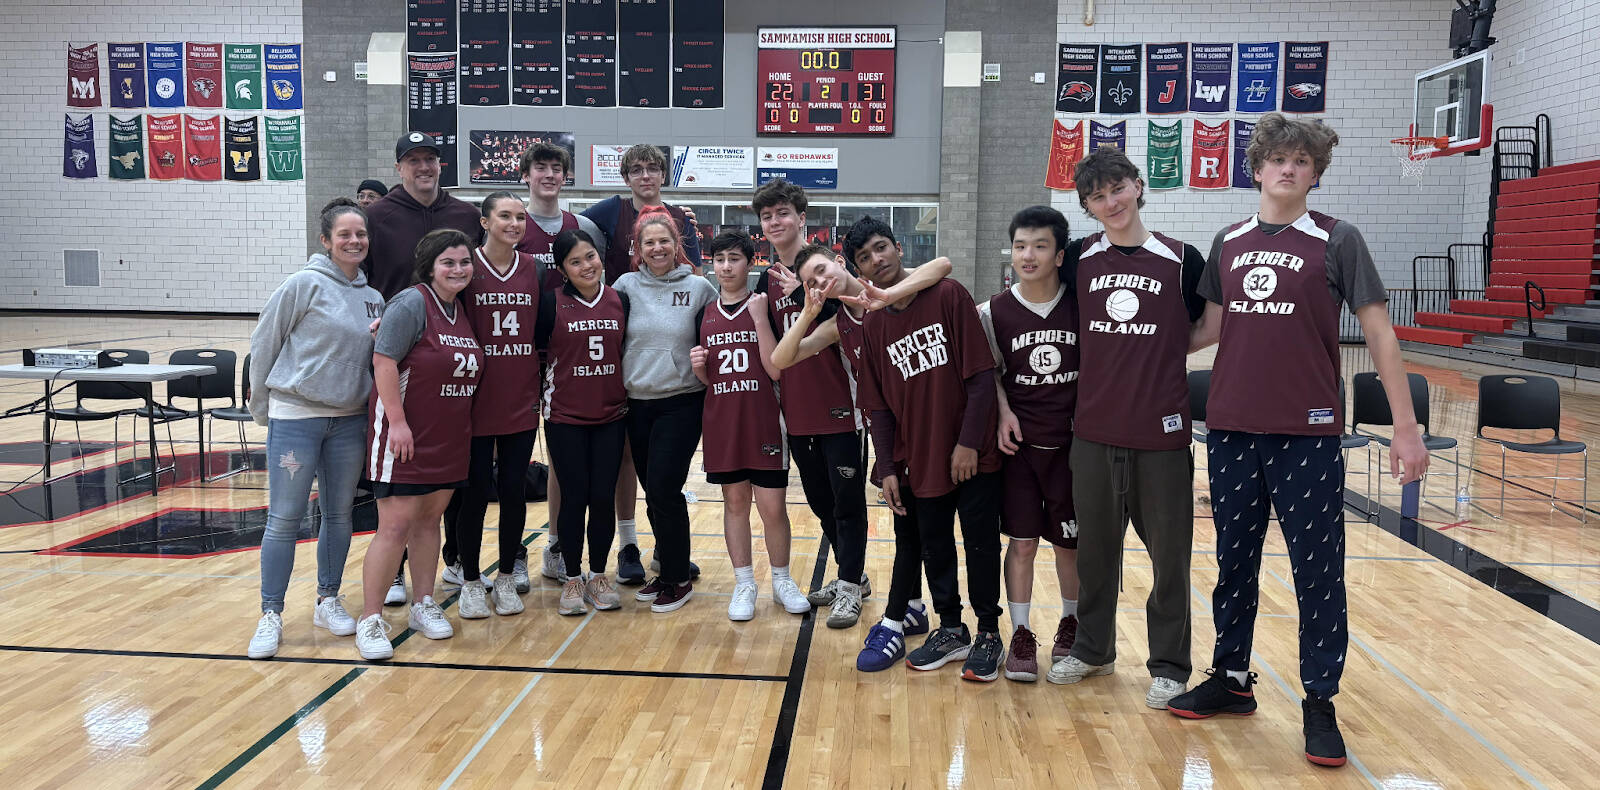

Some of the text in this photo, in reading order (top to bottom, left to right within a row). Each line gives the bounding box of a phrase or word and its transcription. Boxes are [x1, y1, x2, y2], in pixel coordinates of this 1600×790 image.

[761, 33, 892, 43] SAMMAMISH HIGH SCHOOL
[801, 52, 839, 69] 00.0
[769, 72, 791, 81] HOME
[858, 73, 884, 81] GUEST
[771, 84, 793, 100] 22
[822, 85, 830, 99] 2
[864, 84, 884, 100] 31
[1158, 80, 1176, 103] J
[770, 109, 779, 123] 0
[790, 109, 799, 123] 0
[852, 109, 860, 123] 0
[876, 109, 884, 123] 0
[269, 150, 298, 172] W
[1198, 157, 1219, 178] R
[1230, 251, 1304, 272] MERCER
[1089, 273, 1162, 295] MERCER
[1250, 274, 1269, 291] 32
[475, 293, 532, 306] MERCER
[492, 310, 520, 336] 14
[568, 319, 619, 333] MERCER
[1089, 320, 1157, 335] ISLAND
[706, 331, 758, 347] MERCER
[886, 322, 948, 366] MERCER
[1012, 329, 1076, 352] MERCER
[485, 344, 532, 356] SLAND
[589, 335, 604, 361] 5
[453, 352, 479, 378] 24
[718, 348, 749, 374] 20
[1039, 352, 1051, 367] 15
[573, 364, 615, 377] ISLAND
[1015, 370, 1078, 385] ISLAND
[713, 380, 759, 395] ISLAND
